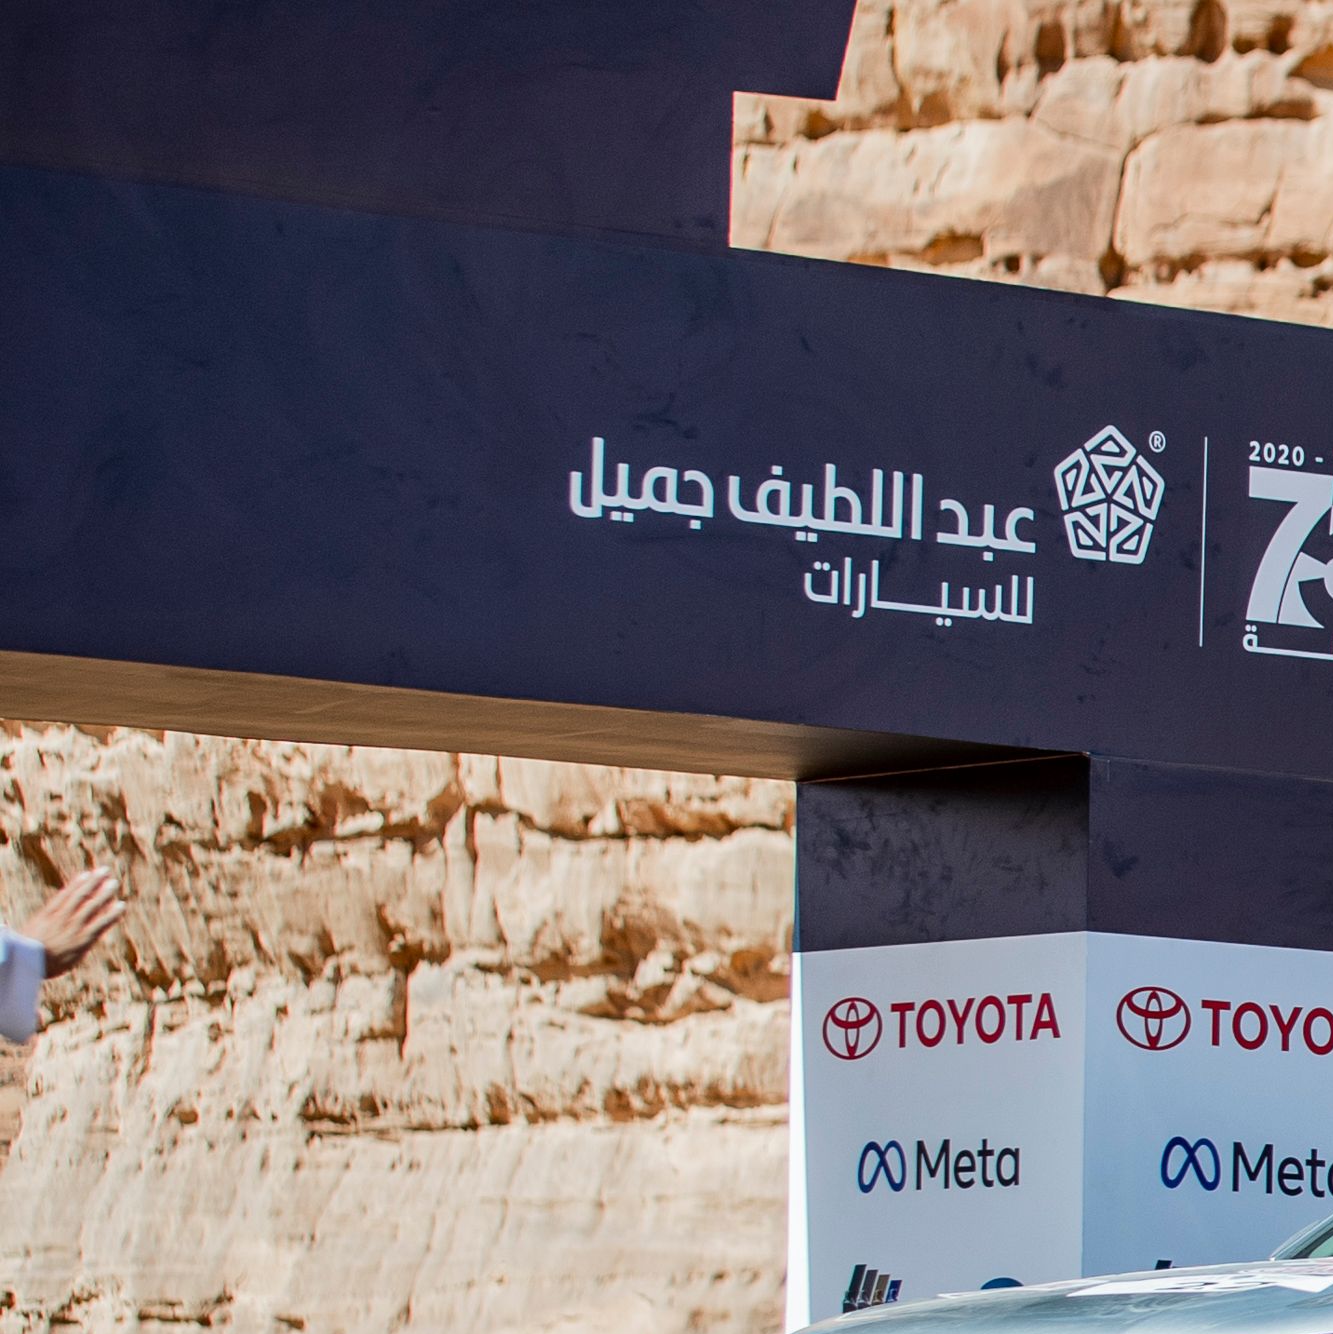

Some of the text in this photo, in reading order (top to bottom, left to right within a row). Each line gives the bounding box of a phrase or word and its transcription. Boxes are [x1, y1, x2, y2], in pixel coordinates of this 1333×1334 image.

[1248, 440, 1305, 467] 2020
[568, 436, 1037, 562] عبد اللطيف جميل
[891, 992, 1062, 1049] TOYOTA
[915, 1138, 1021, 1191] Meta
